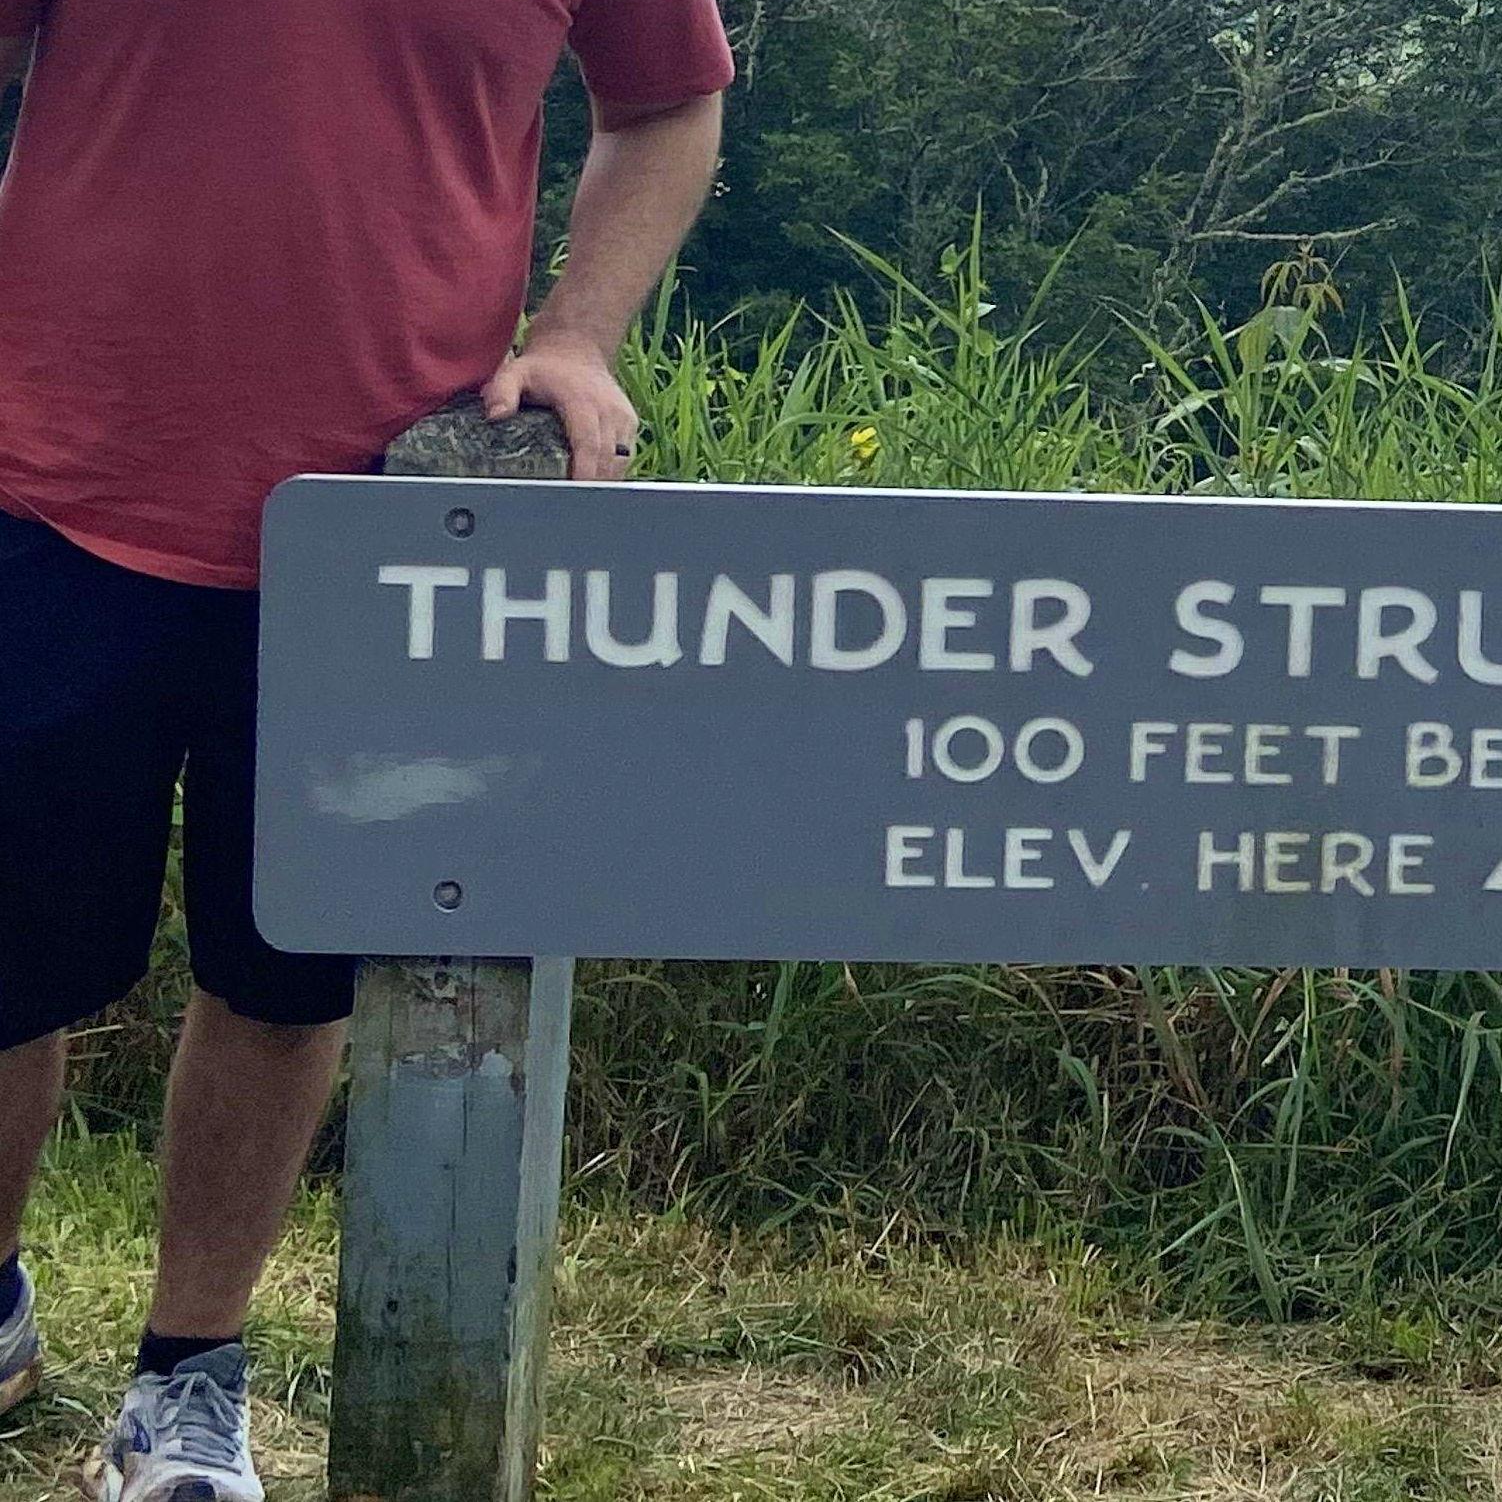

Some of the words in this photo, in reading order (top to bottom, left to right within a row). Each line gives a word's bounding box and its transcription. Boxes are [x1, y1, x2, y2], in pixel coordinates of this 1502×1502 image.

[378, 565, 1094, 677] THUNDER
[905, 715, 1084, 783] 100
[1130, 722, 1361, 785] FEET
[1197, 831, 1435, 896] HERE
